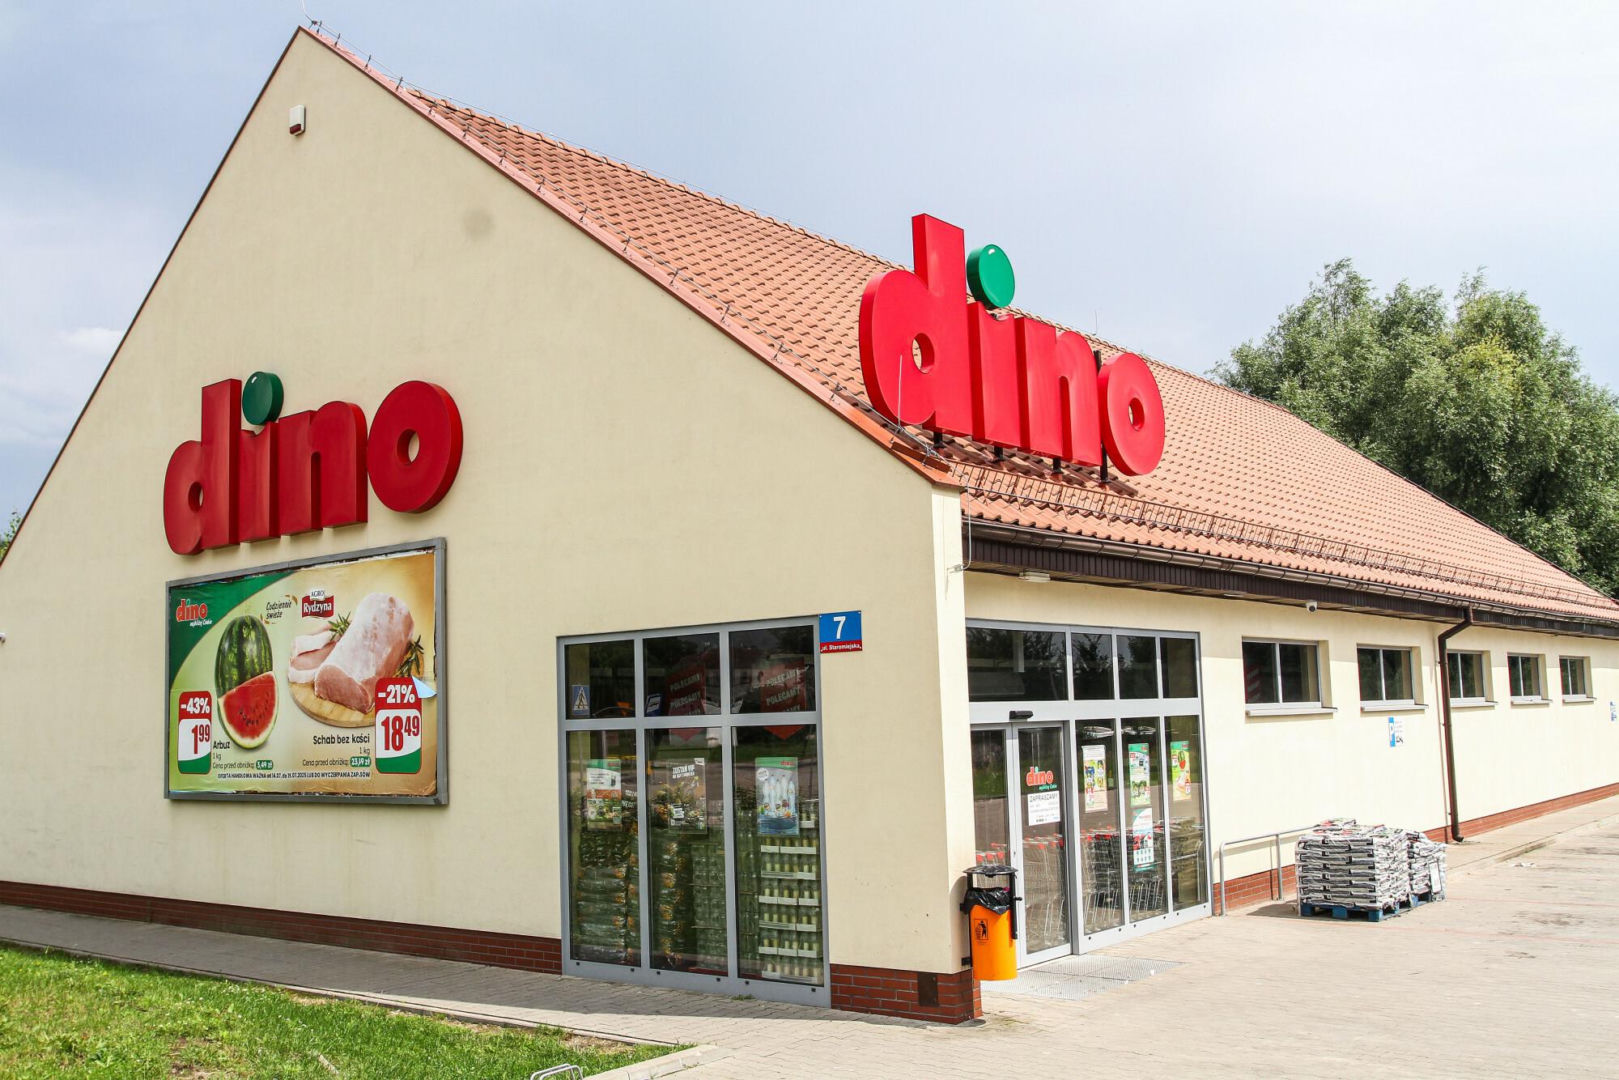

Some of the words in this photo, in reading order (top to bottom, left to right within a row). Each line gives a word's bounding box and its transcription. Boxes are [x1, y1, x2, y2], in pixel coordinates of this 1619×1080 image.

[858, 212, 1166, 477] dino
[163, 371, 463, 556] dino
[176, 599, 208, 622] dino
[303, 601, 332, 614] Rydzyna
[833, 616, 846, 640] 7
[378, 684, 415, 704] -21%
[181, 697, 210, 714] -43%
[213, 740, 230, 749] Arbuz
[313, 734, 335, 745] Schab
[337, 734, 349, 744] bez
[352, 733, 370, 744] kości
[1026, 766, 1054, 786] dino
